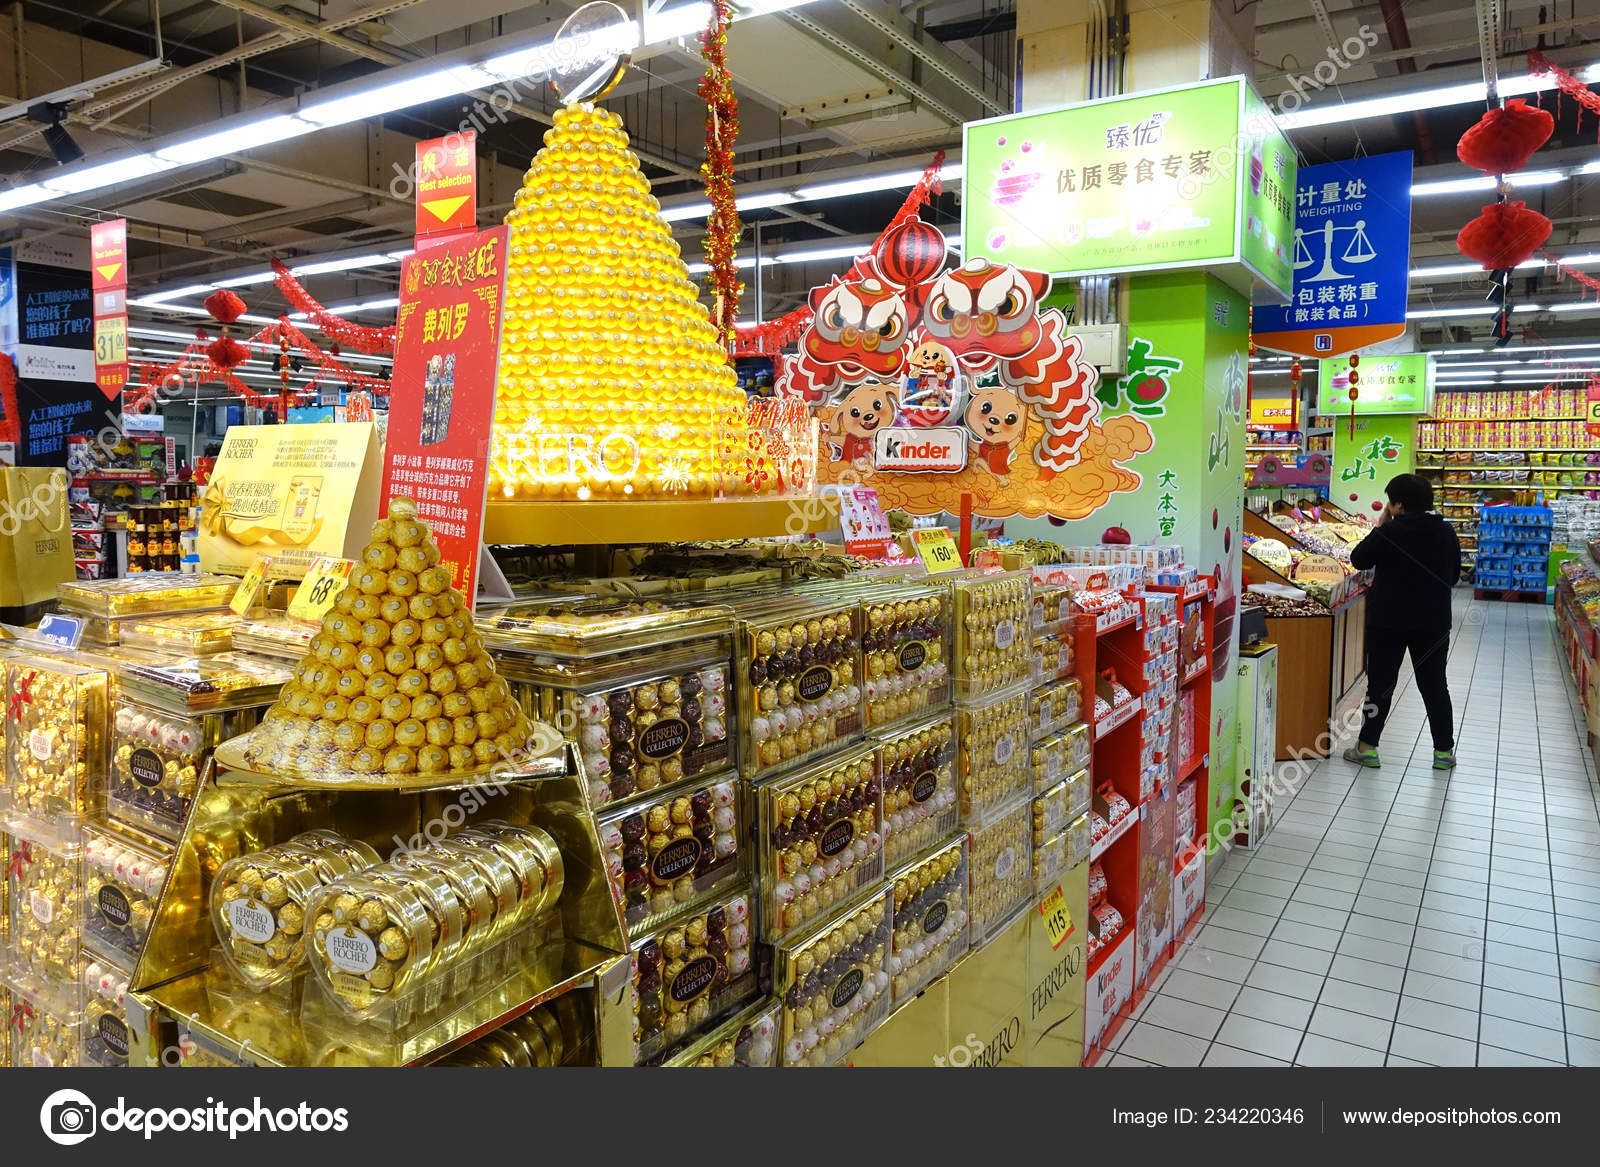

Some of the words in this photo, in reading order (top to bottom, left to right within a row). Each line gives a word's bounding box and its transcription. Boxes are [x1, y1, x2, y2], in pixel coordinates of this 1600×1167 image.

[438, 174, 472, 189] selection
[1056, 150, 1212, 194] 优质零食专家
[1297, 178, 1367, 207] 计量处
[1300, 202, 1362, 218] WEIGHTING
[1280, 282, 1378, 307] 包装称重
[423, 302, 469, 344] 费列罗
[97, 334, 114, 361] 31
[115, 333, 125, 347] 00
[1157, 470, 1178, 538] 大本营
[931, 546, 951, 562] 160
[309, 576, 334, 605] 68
[646, 720, 684, 744] FERRERO
[646, 734, 684, 754] COLLECTION
[133, 766, 160, 783] COLLECTION
[134, 754, 160, 772] FERRERO
[659, 841, 696, 864] FERRERO
[659, 853, 696, 876] COLLECTION
[235, 906, 268, 925] FERRERO
[235, 915, 268, 935] ROCHER
[1048, 909, 1066, 938] 115
[333, 937, 369, 954] FERRERO
[333, 948, 369, 965] ROCHER
[677, 957, 713, 988] FERRERO
[1032, 946, 1081, 1021] FERRERO
[677, 970, 713, 999] COLLECTION
